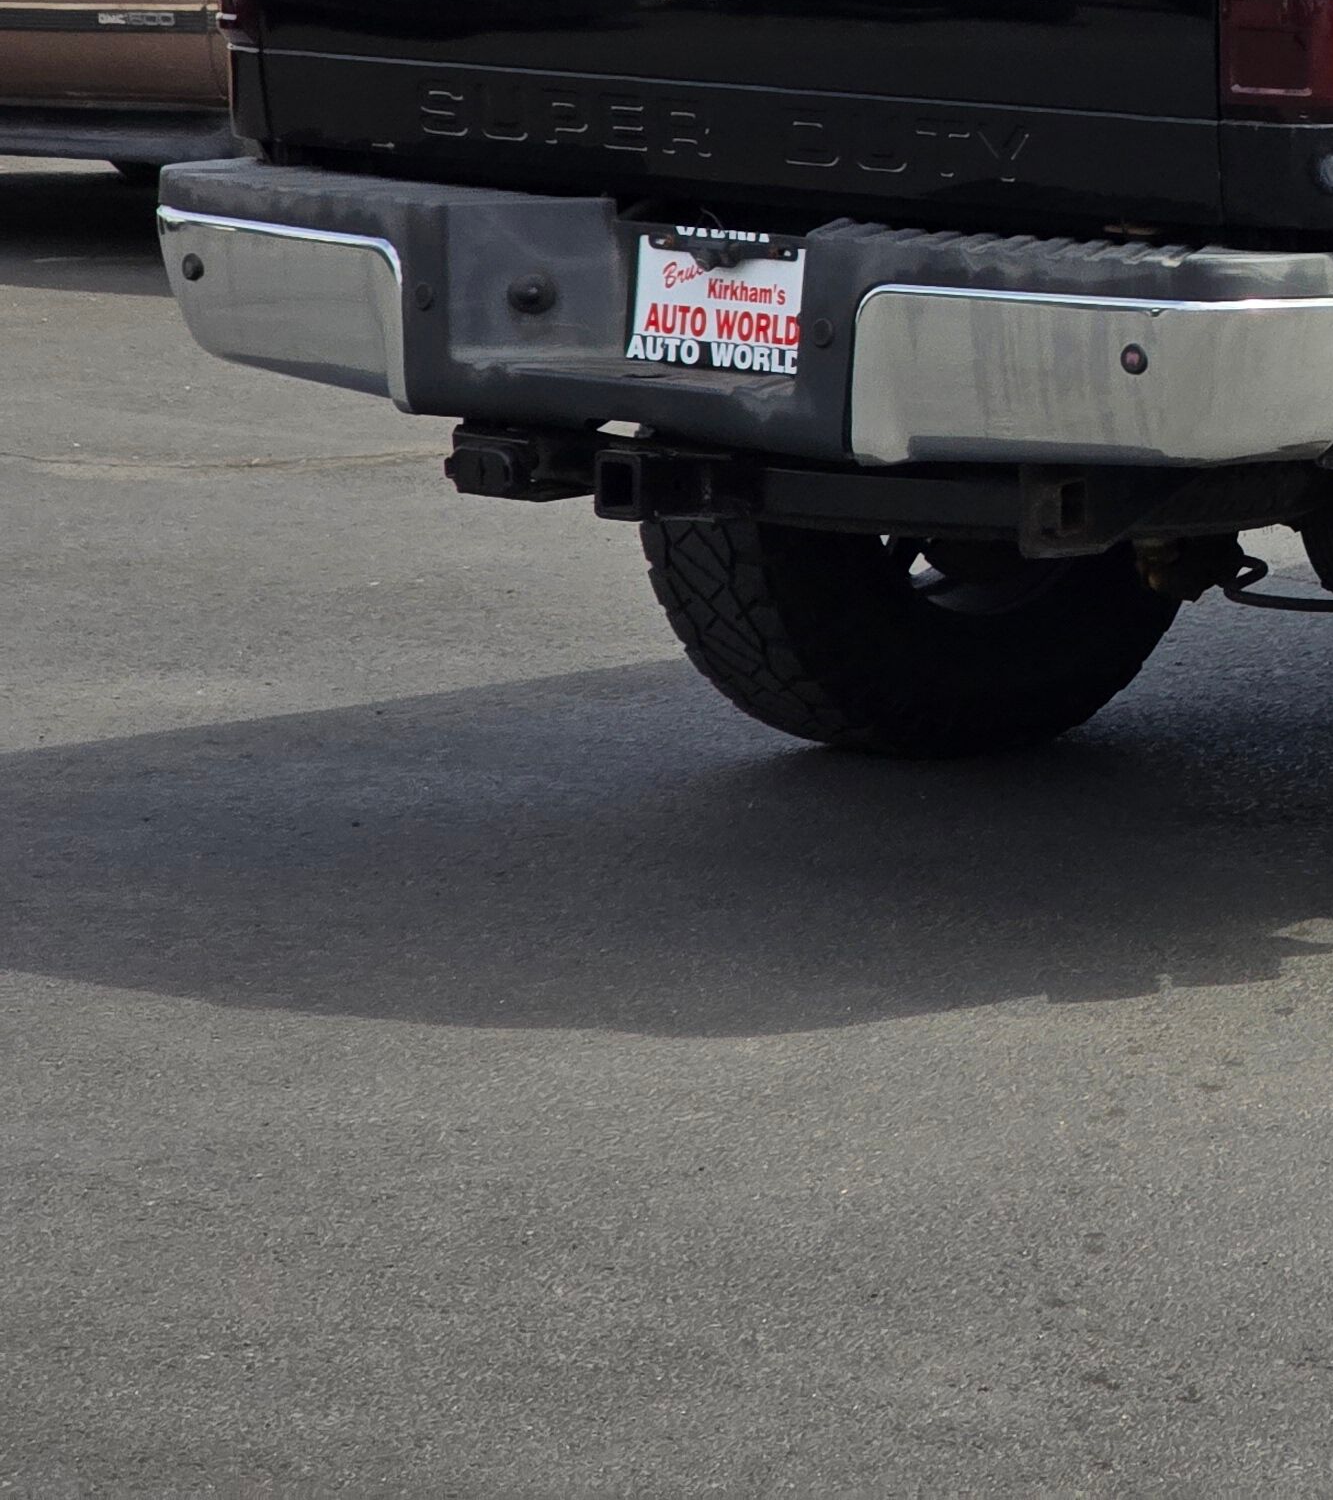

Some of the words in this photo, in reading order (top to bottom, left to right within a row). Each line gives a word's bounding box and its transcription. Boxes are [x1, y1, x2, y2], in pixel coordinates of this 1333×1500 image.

[418, 78, 712, 159] SUPER
[782, 106, 1030, 184] DUTY
[707, 277, 786, 306] Kirkham's
[644, 302, 707, 338] AUTO
[715, 308, 800, 346] WORLD
[625, 334, 700, 366] AUTO
[709, 341, 798, 375] WORLD
